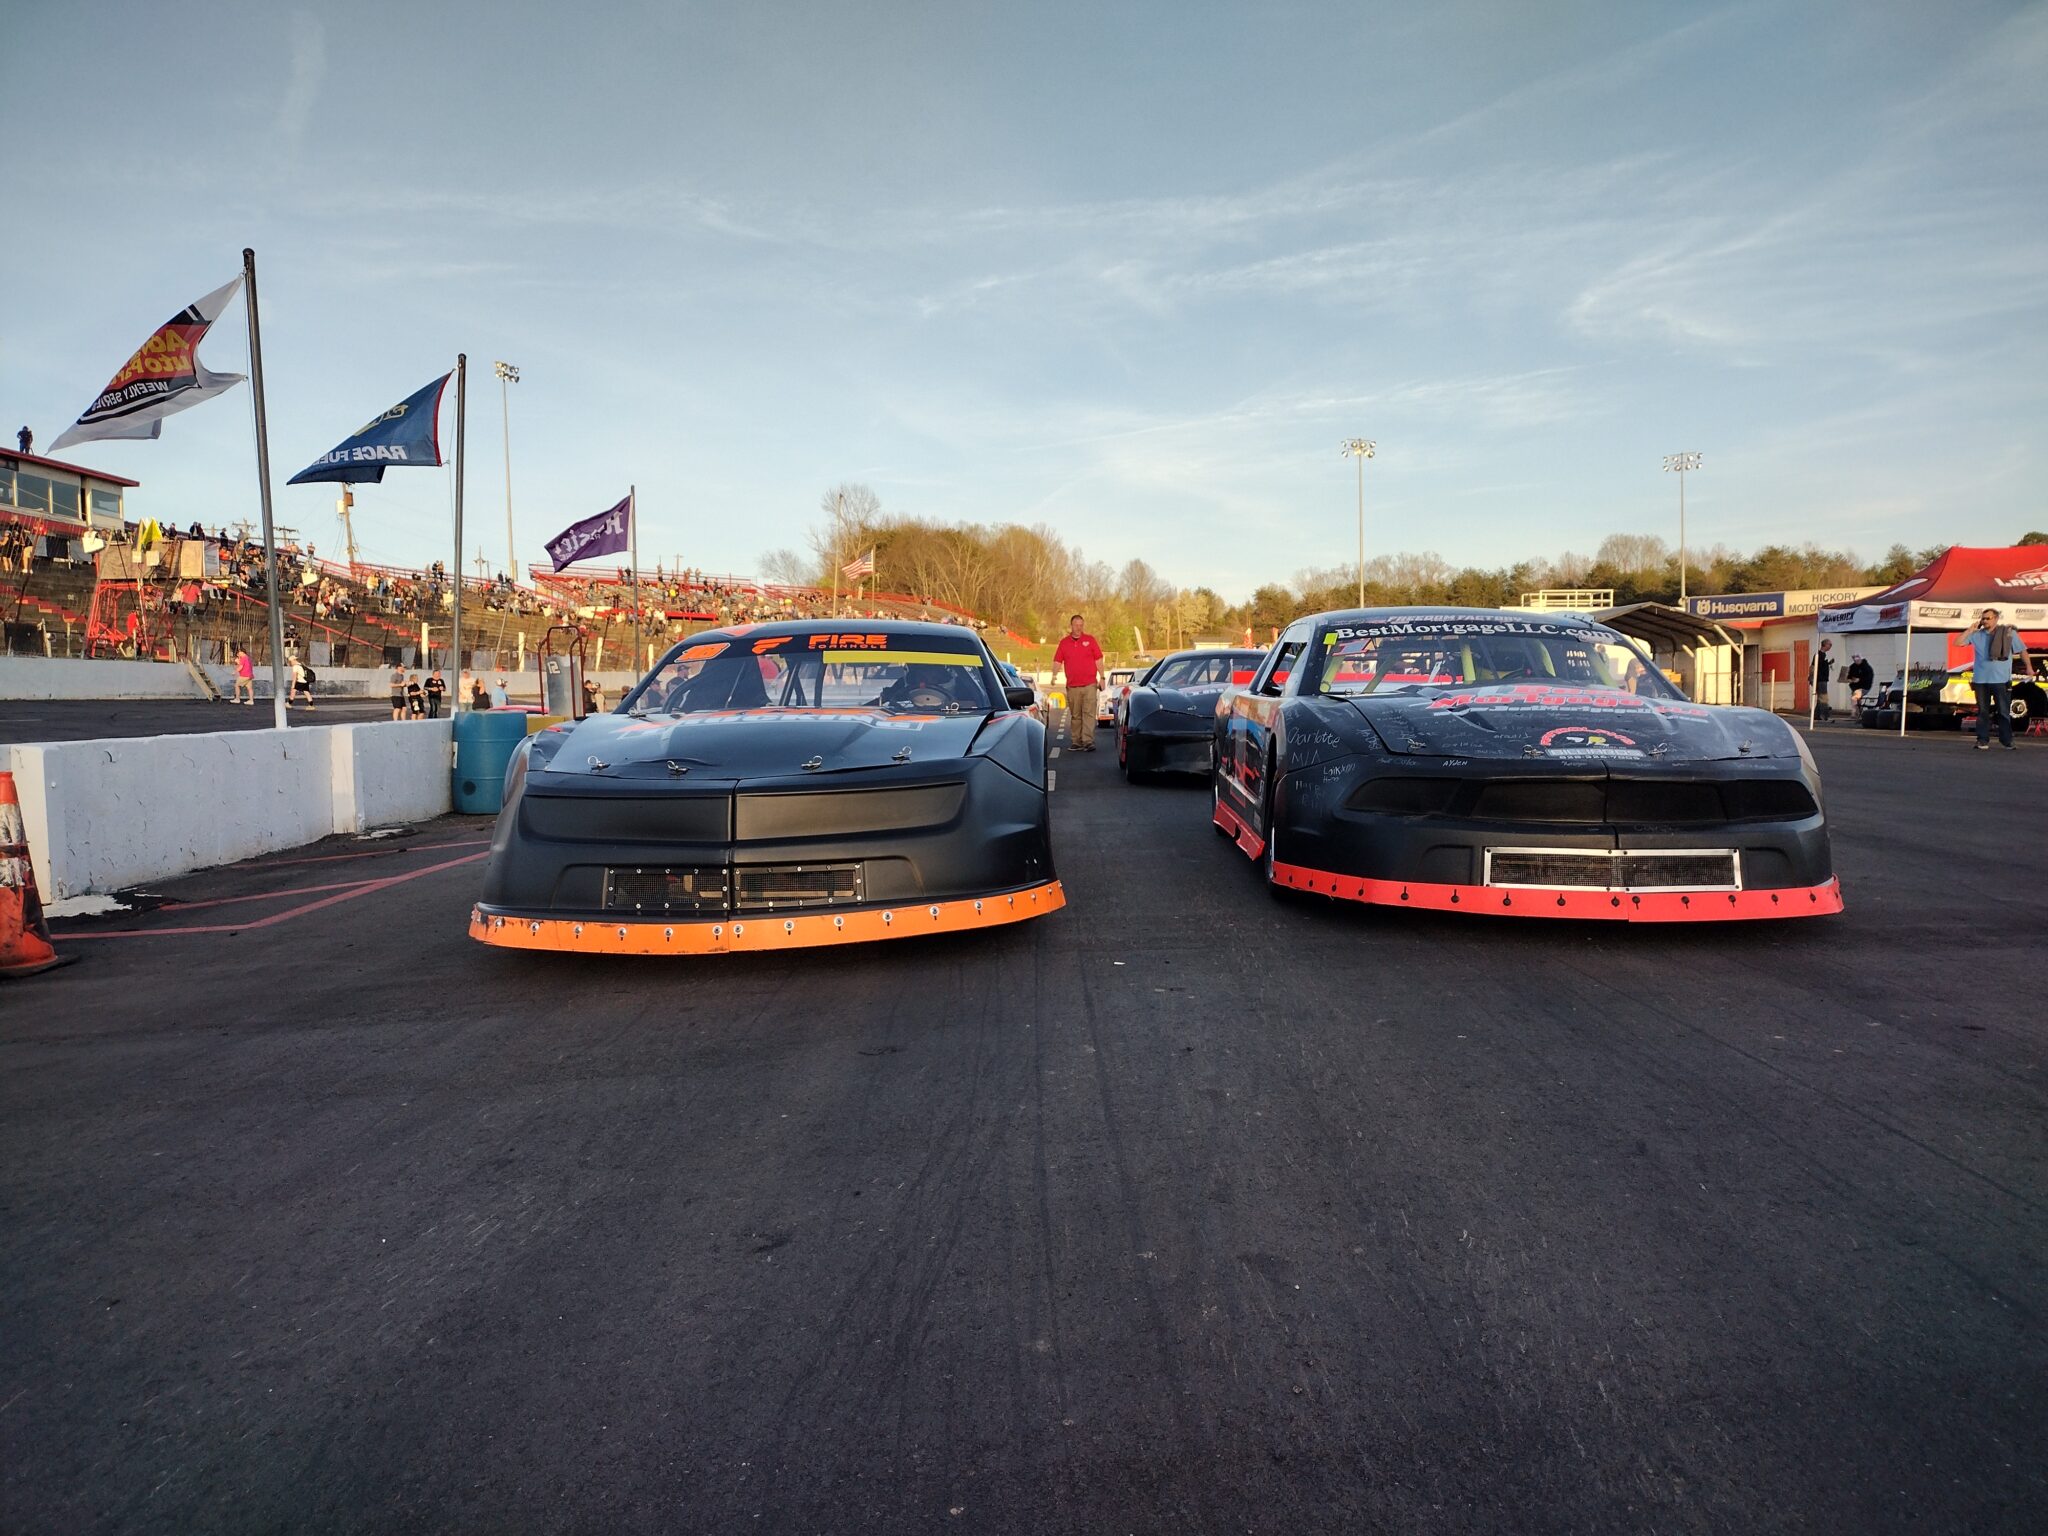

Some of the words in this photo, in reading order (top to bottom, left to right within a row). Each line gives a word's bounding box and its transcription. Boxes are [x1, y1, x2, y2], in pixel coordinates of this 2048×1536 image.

[1812, 592, 1858, 603] HICKORY
[1711, 601, 1777, 615] Husqvarna
[1335, 623, 1613, 640] BestMortgageLLC.com
[808, 635, 887, 645] FIRE
[547, 661, 560, 674] 12
